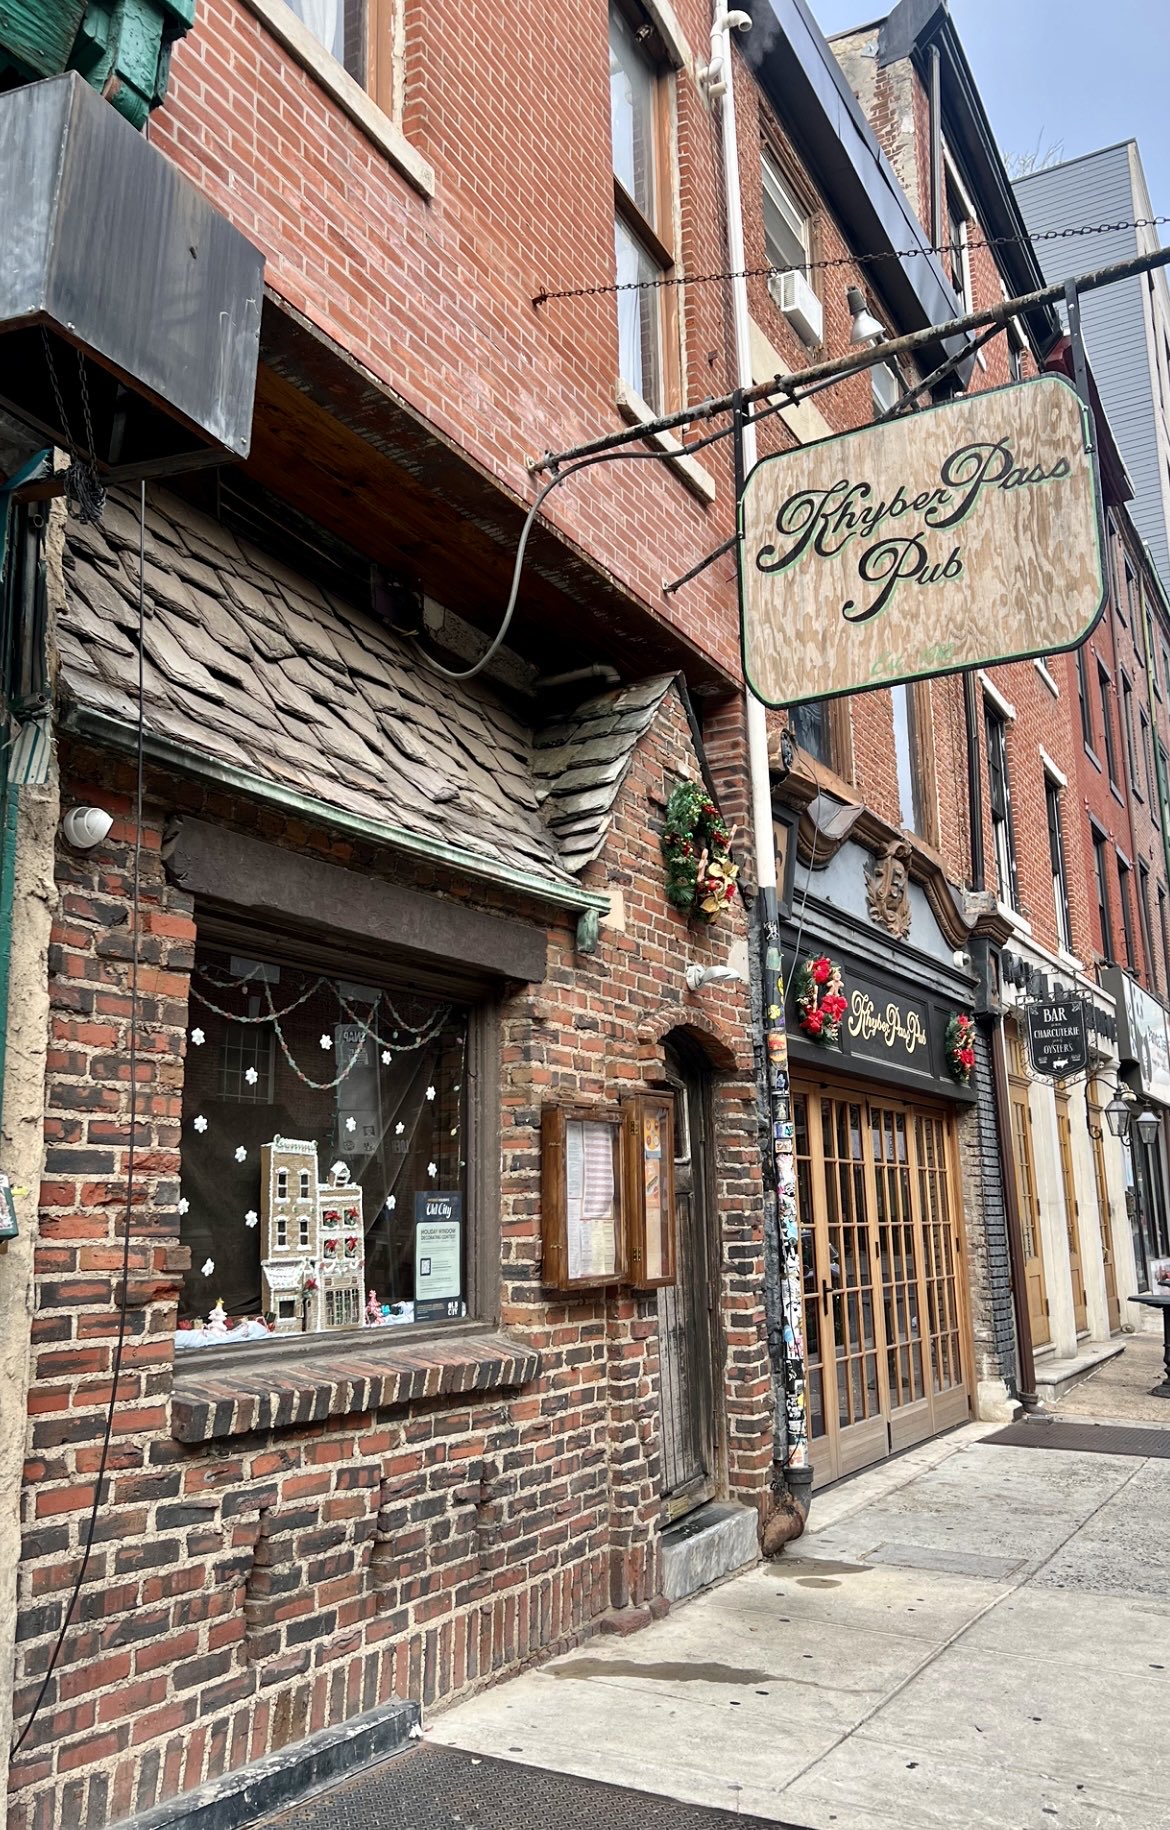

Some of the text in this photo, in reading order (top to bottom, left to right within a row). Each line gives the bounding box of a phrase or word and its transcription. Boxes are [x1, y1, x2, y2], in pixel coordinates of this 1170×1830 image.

[756, 436, 1071, 573] Khyber Pass
[842, 532, 963, 623] Pub
[848, 990, 890, 1040] Khyber
[905, 1011, 927, 1053] Pub
[1043, 1007, 1067, 1022] BAR
[1034, 1027, 1079, 1039] CHARCUTERIE
[1043, 1043, 1073, 1054] OYSTERS
[438, 1203, 452, 1219] City
